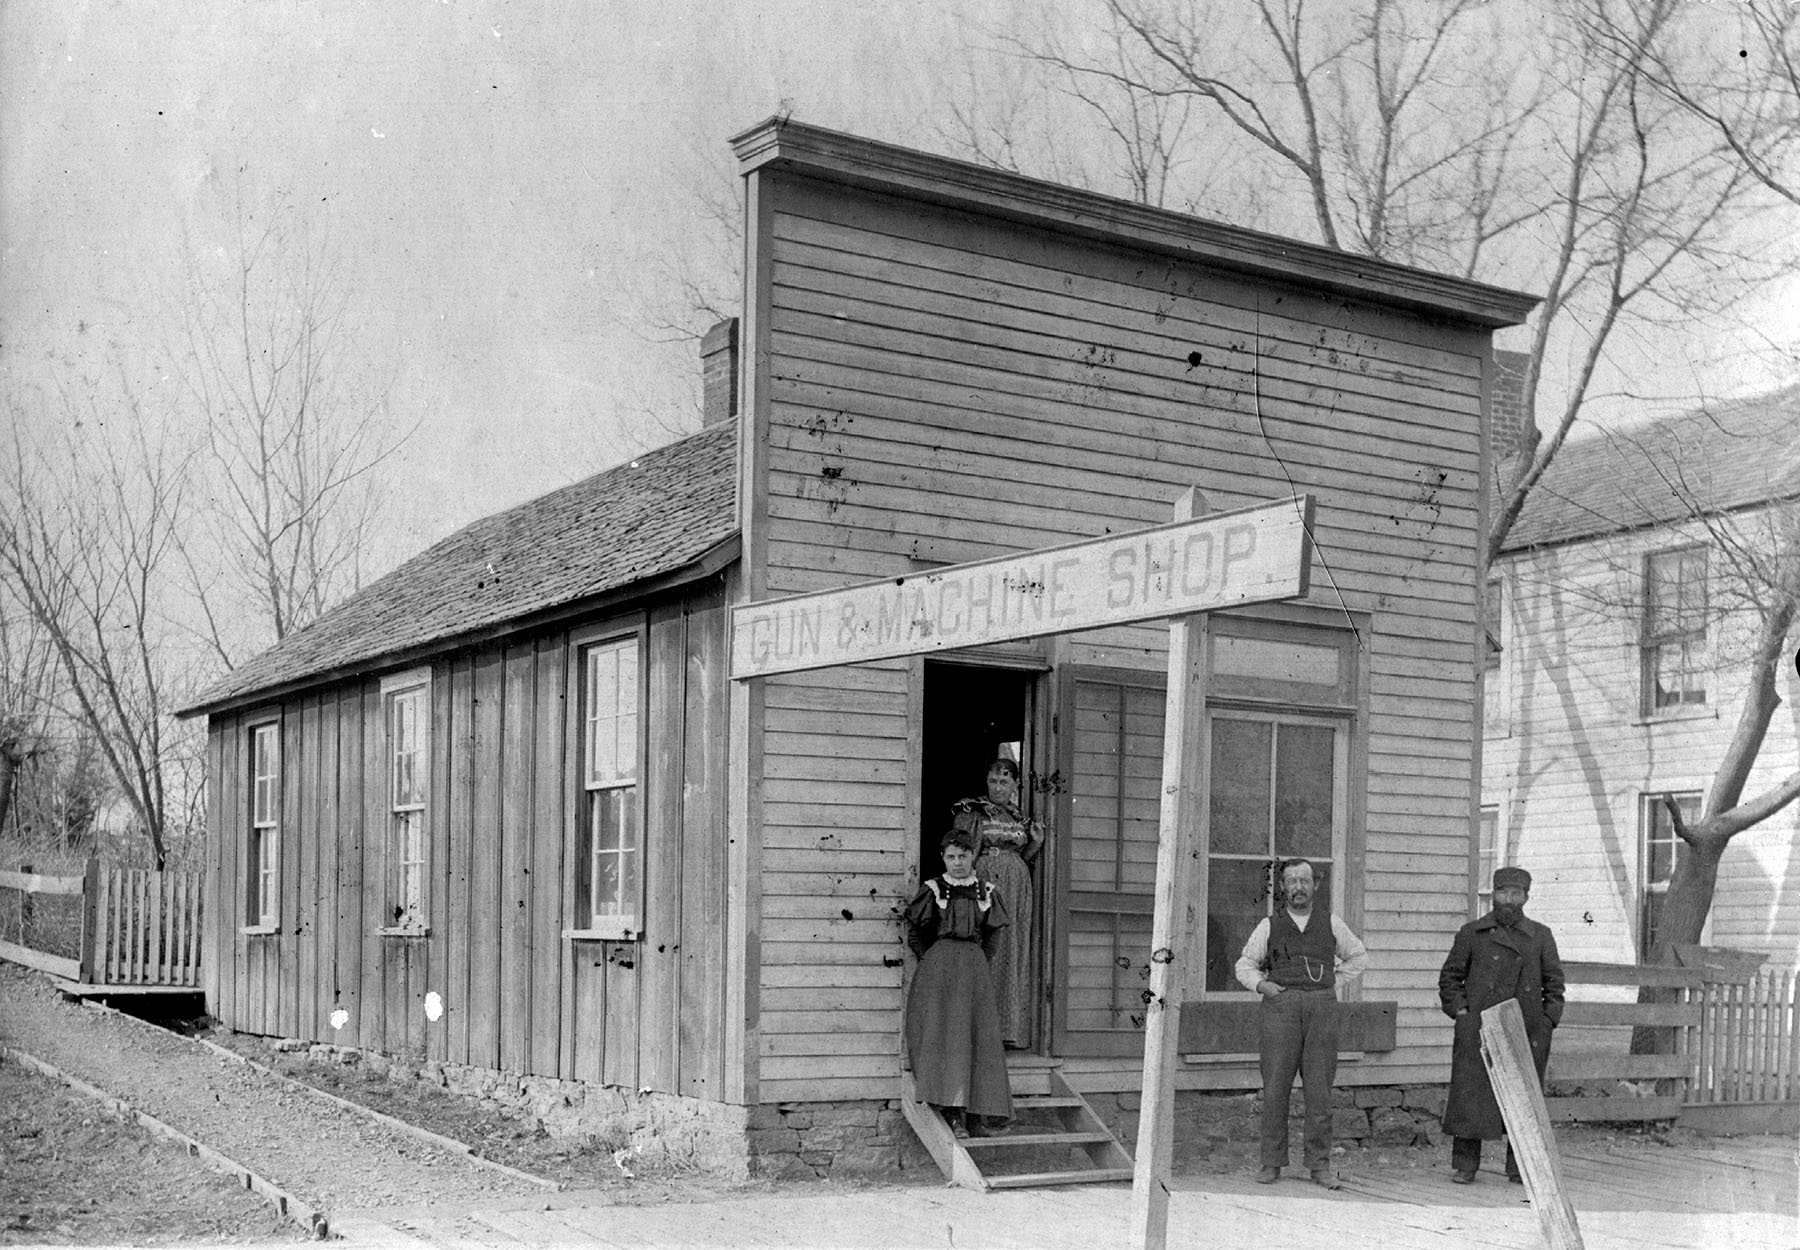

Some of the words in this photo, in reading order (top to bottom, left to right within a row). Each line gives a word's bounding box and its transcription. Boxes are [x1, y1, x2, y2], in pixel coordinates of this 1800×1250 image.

[751, 606, 822, 668] GUN
[837, 602, 857, 649] &
[876, 558, 1080, 646] MACHINE
